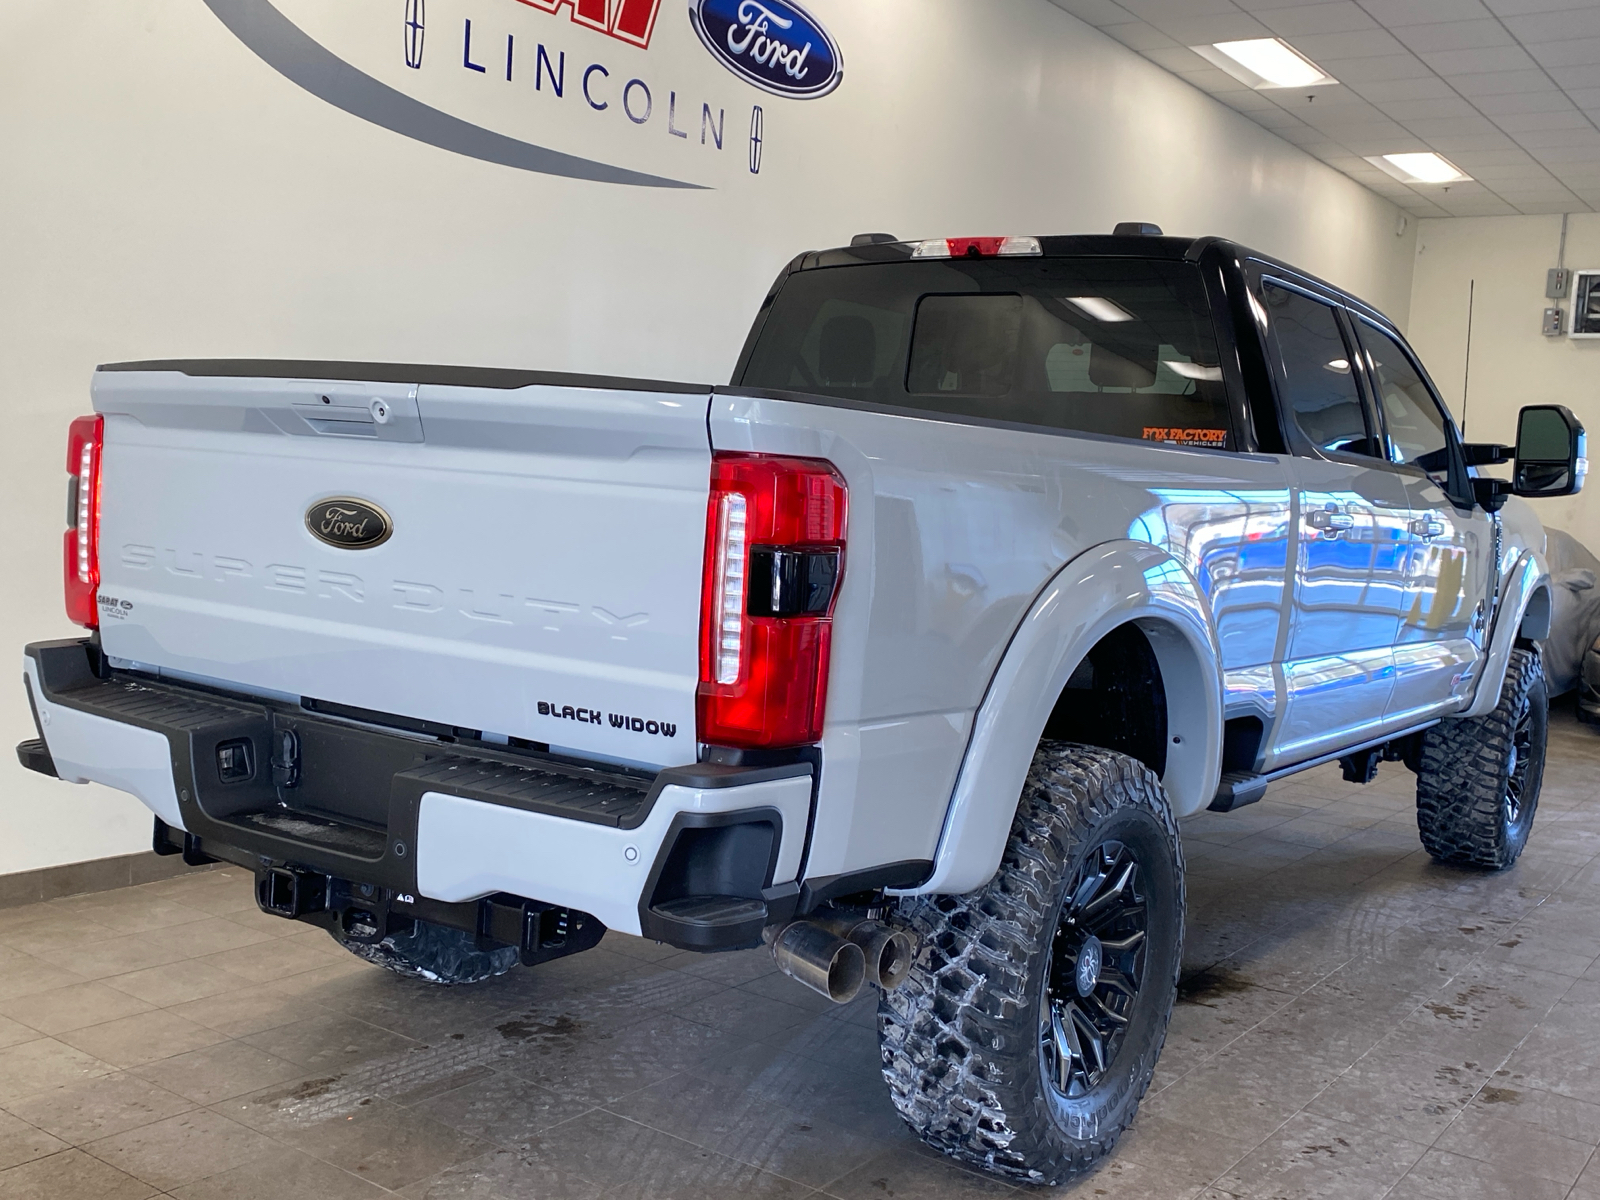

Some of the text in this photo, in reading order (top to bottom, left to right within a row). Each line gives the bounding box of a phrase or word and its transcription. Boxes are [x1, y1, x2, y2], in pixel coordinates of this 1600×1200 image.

[727, 0, 811, 80] Ford
[462, 18, 725, 151] LINCOLN
[1142, 427, 1227, 443] FOX FACTORY
[321, 506, 369, 538] Ford
[122, 543, 649, 640] SUPER DUTY
[102, 606, 128, 617] LINCOLN
[537, 700, 677, 738] BLACK WIDOW
